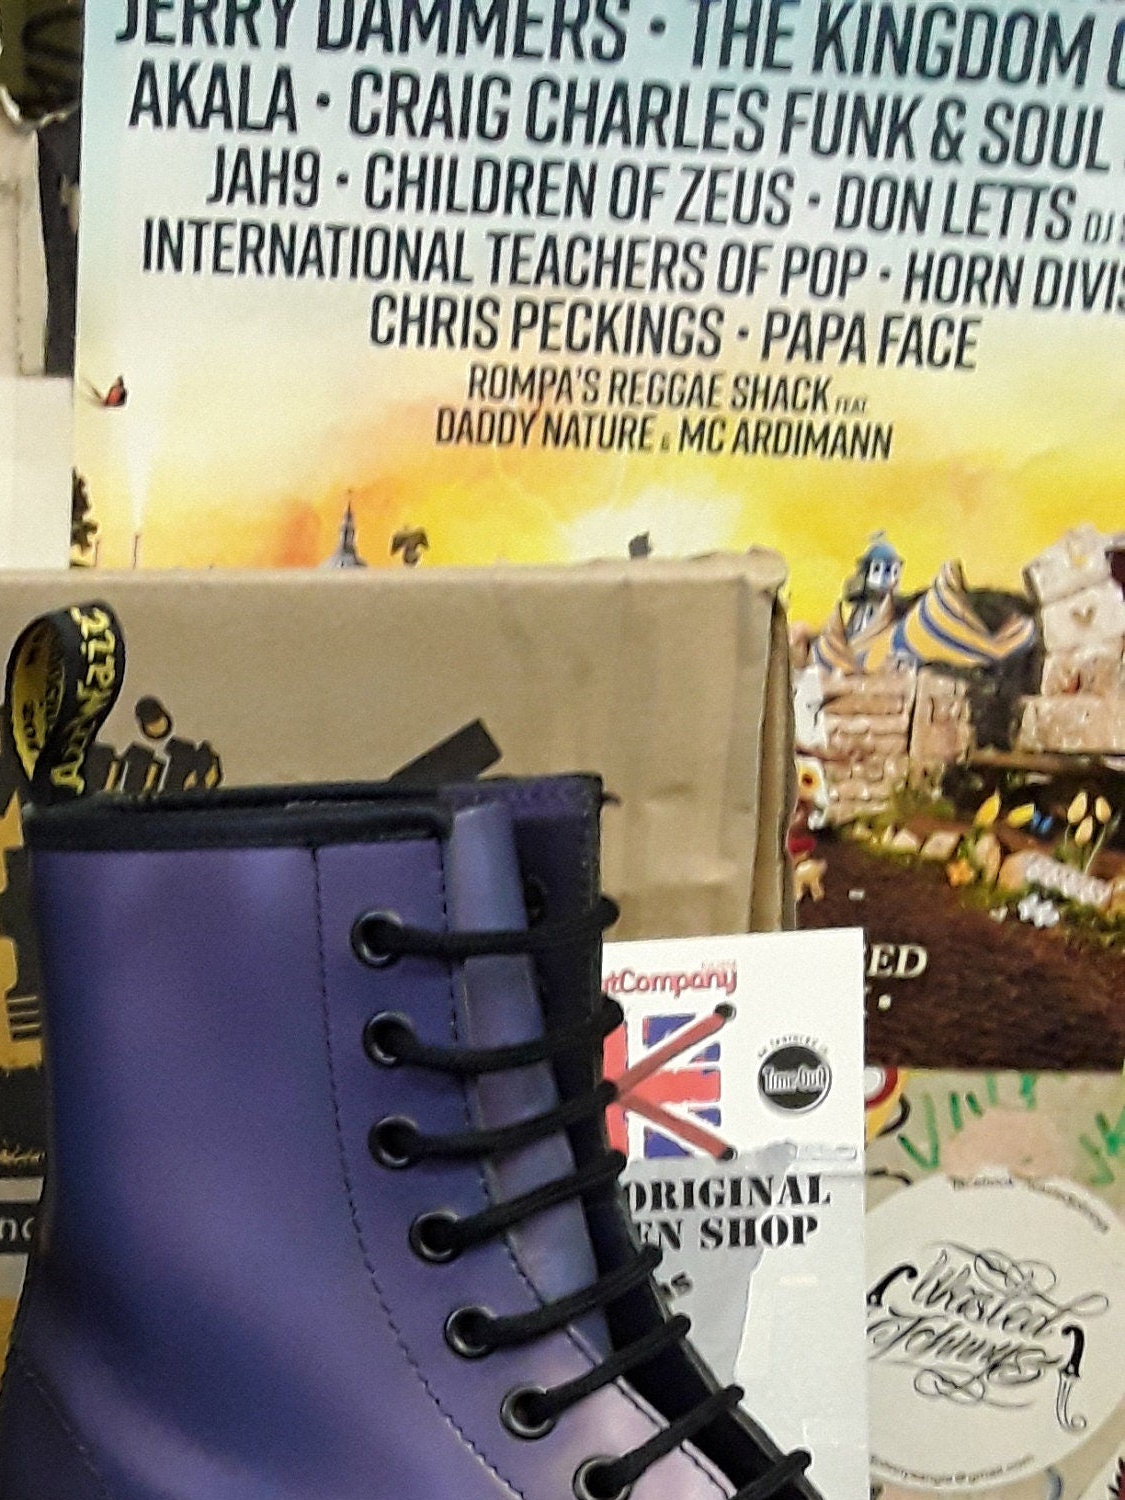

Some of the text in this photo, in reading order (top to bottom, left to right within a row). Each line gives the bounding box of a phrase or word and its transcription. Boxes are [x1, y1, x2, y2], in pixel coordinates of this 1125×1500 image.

[116, 0, 299, 49] JERRY
[316, 0, 626, 63] DAMMERS
[691, 0, 793, 72] THE
[811, 0, 1095, 91] KINGDOM
[128, 60, 1111, 173] AKALA CRAIG CHARLES FUNK & SOUL
[207, 146, 321, 209] JAH9
[364, 150, 599, 219] CHILDREN
[609, 161, 669, 223] OF
[676, 165, 795, 229] ZEUS
[834, 173, 933, 236] DON
[942, 180, 1076, 243] LETTS
[1083, 209, 1115, 244] DJ
[142, 217, 475, 284] INTERNATIONAL
[486, 230, 707, 294] TEACHERS
[717, 241, 773, 297] OF
[780, 244, 868, 300] POP
[902, 249, 1024, 309] HORN
[369, 292, 982, 372] CHRIS PECKINGS PAPA FACE
[468, 363, 600, 404] ROMPA'S
[608, 368, 723, 410] REGGAE
[730, 374, 833, 414] SHACK
[436, 406, 537, 447] DADDY
[541, 411, 657, 453] NATURE
[678, 416, 726, 454] MC
[730, 419, 894, 460] ARDIMANN
[699, 1214, 820, 1250] SHOP
